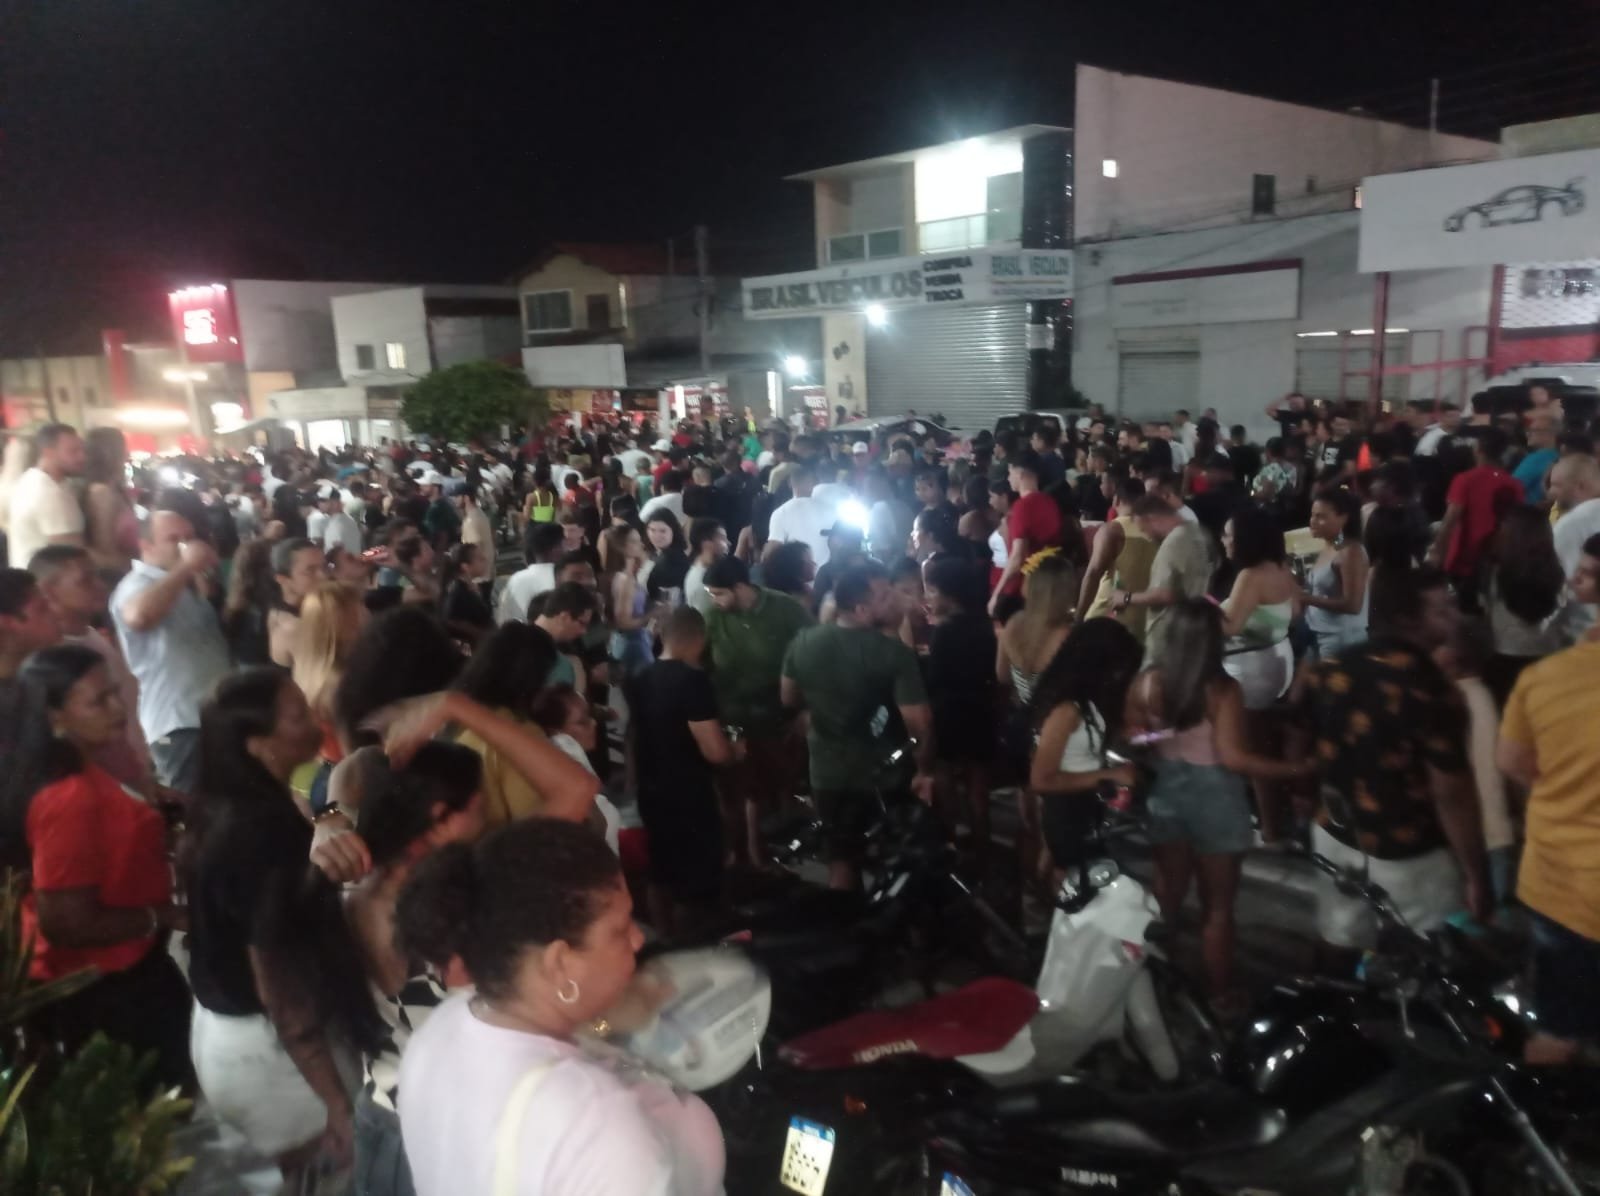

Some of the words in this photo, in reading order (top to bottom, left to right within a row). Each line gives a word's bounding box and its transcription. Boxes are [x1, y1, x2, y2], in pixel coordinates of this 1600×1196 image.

[751, 282, 816, 310] BRASIL
[926, 288, 964, 303] TROCA
[853, 1039, 917, 1063] HONDA
[1061, 1167, 1117, 1188] YAMAHA
